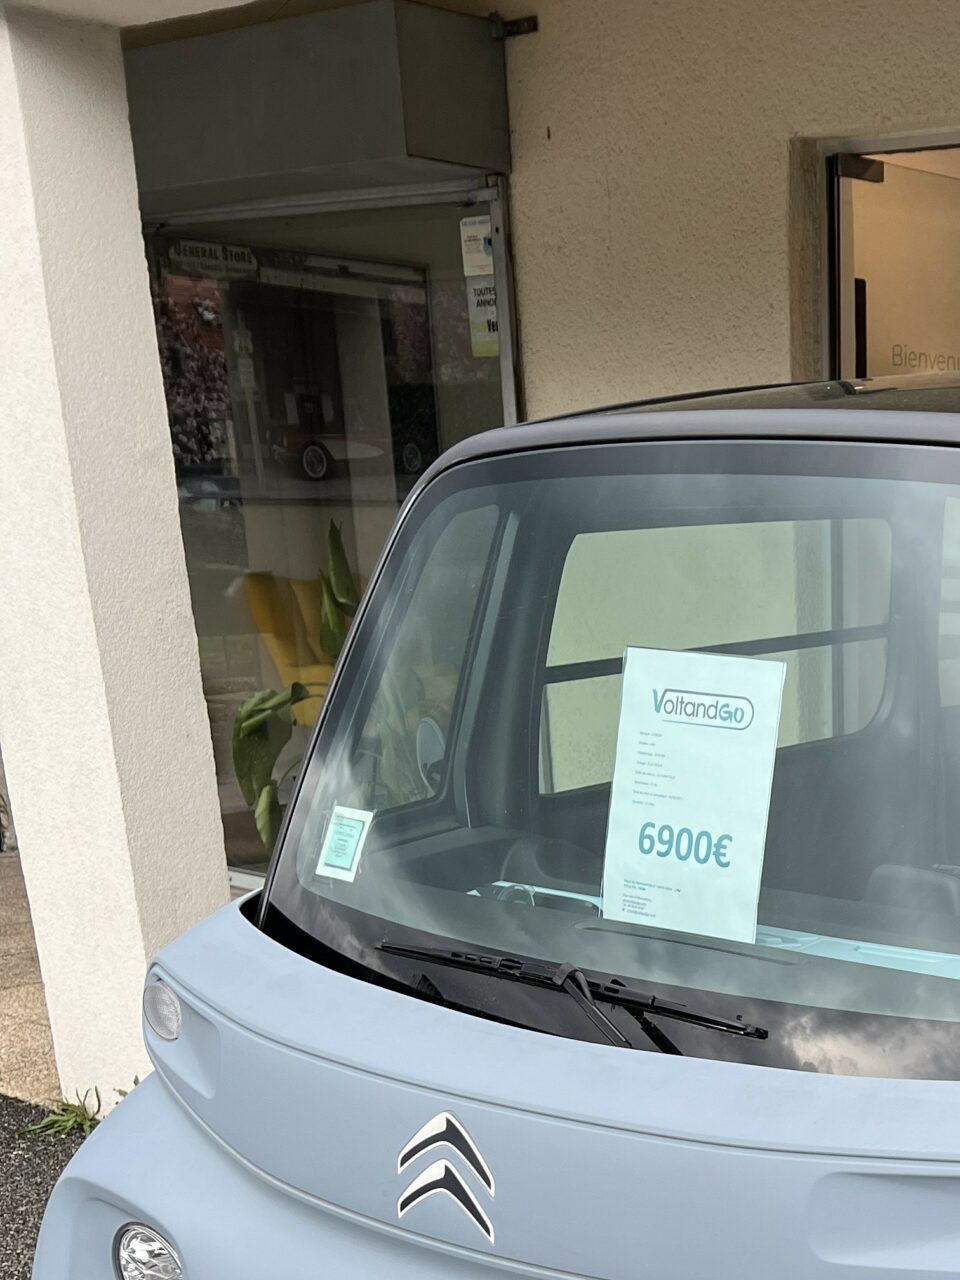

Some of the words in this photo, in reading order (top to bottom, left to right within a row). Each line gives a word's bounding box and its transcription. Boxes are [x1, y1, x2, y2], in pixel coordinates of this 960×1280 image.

[174, 240, 218, 260] GENERAL
[221, 245, 254, 264] STORE
[638, 821, 733, 868] 6900€
